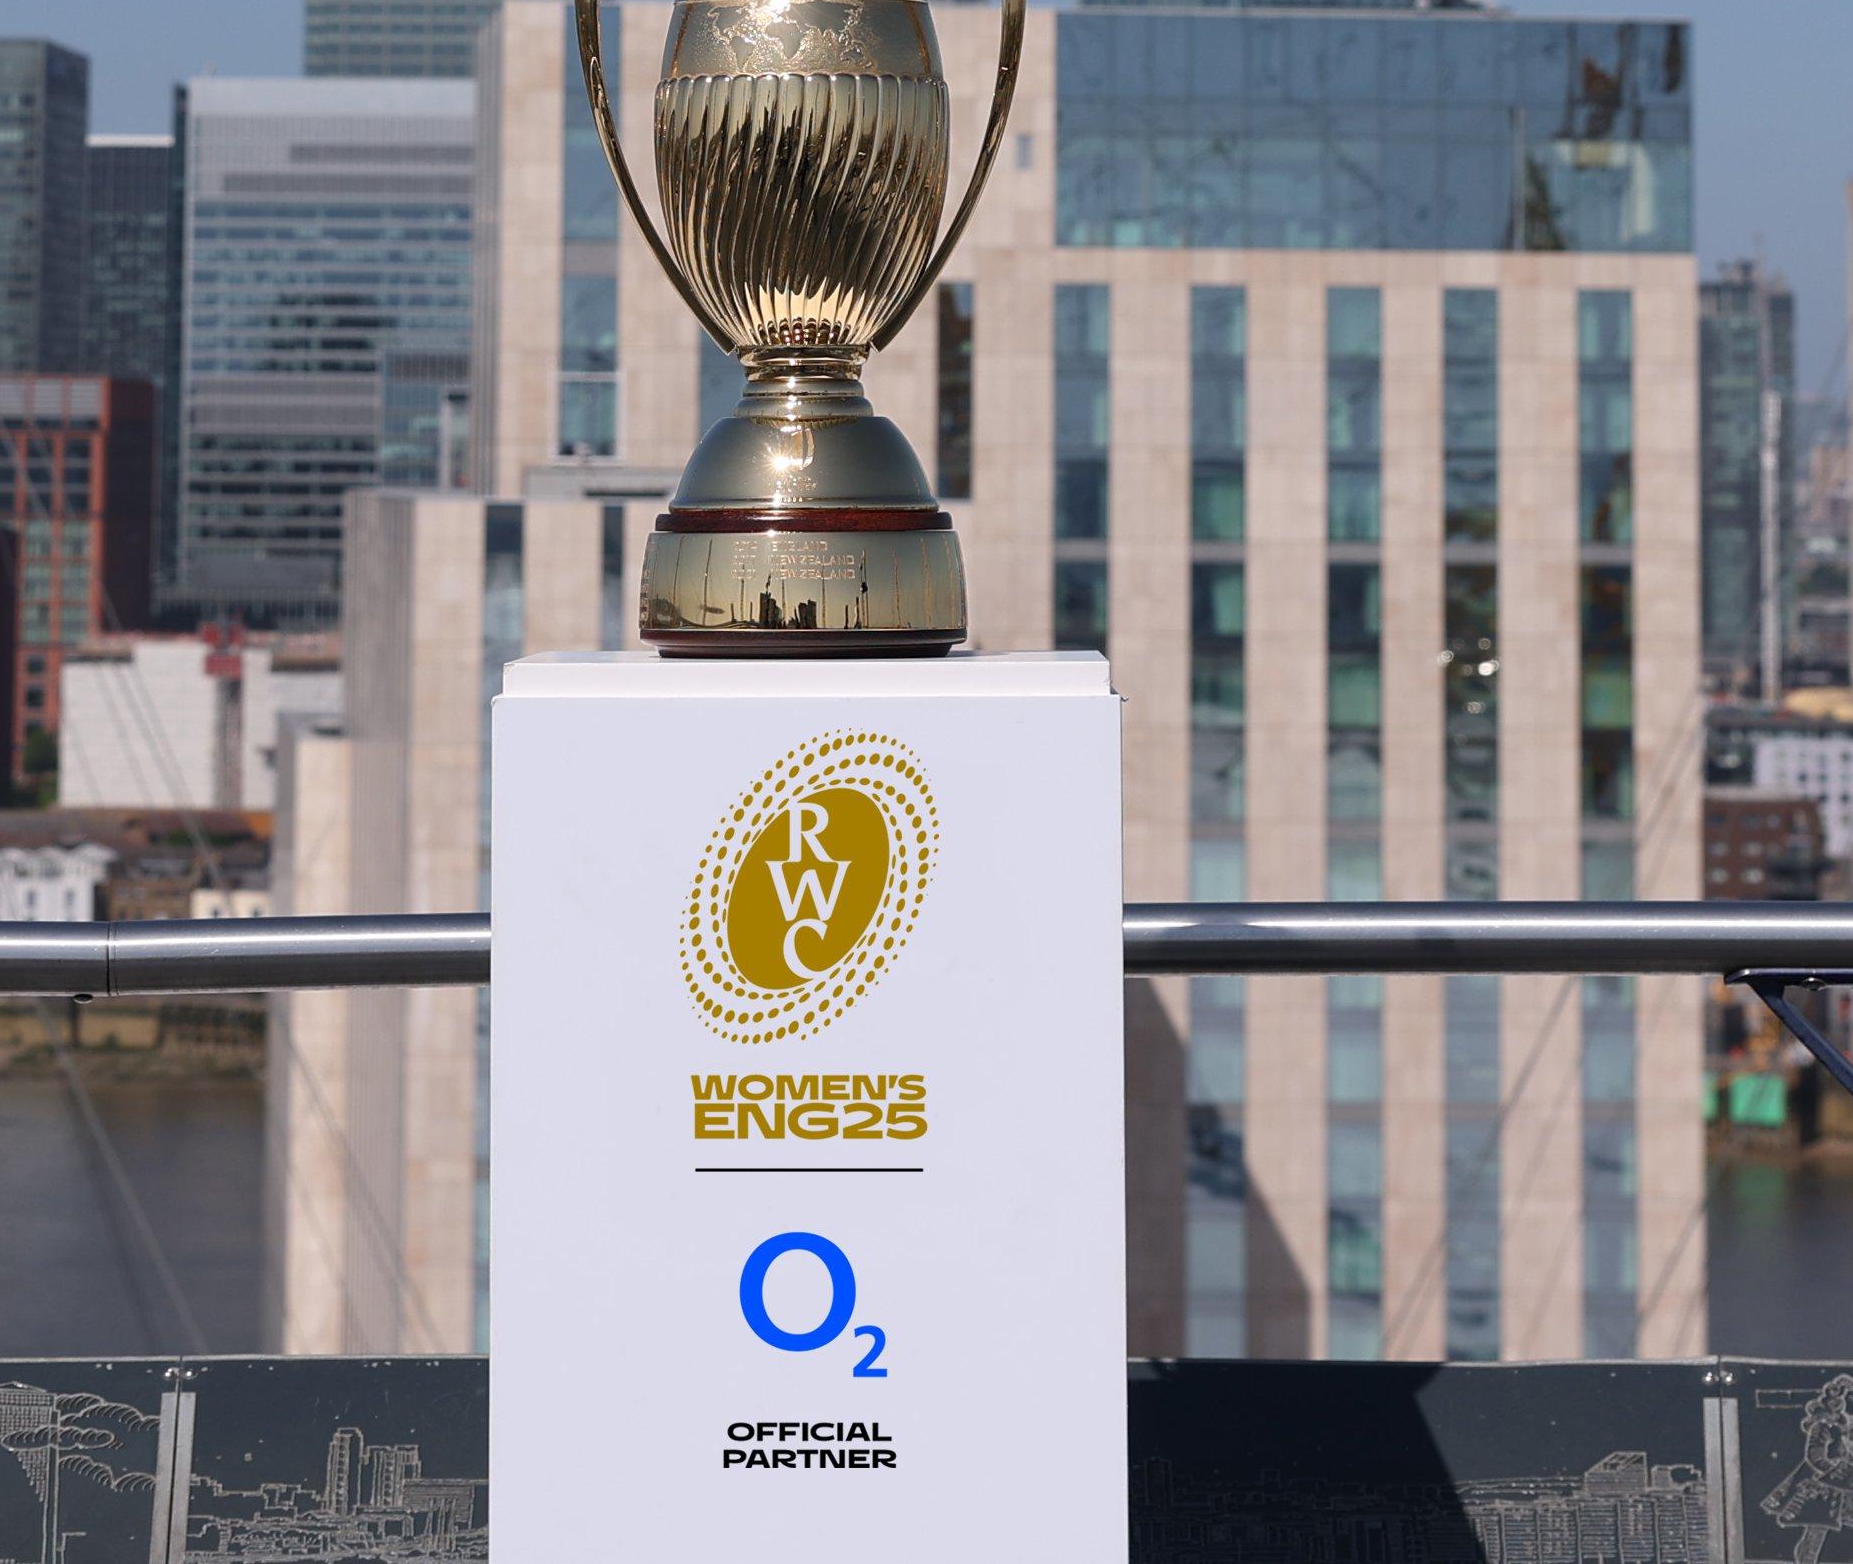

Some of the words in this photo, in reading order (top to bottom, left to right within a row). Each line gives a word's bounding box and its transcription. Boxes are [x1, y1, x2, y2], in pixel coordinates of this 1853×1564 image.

[691, 1074, 927, 1101] WOMEN'S
[694, 1102, 928, 1140] ENG25
[727, 1421, 893, 1443] OFFICIAL
[722, 1448, 898, 1469] PARTNER
